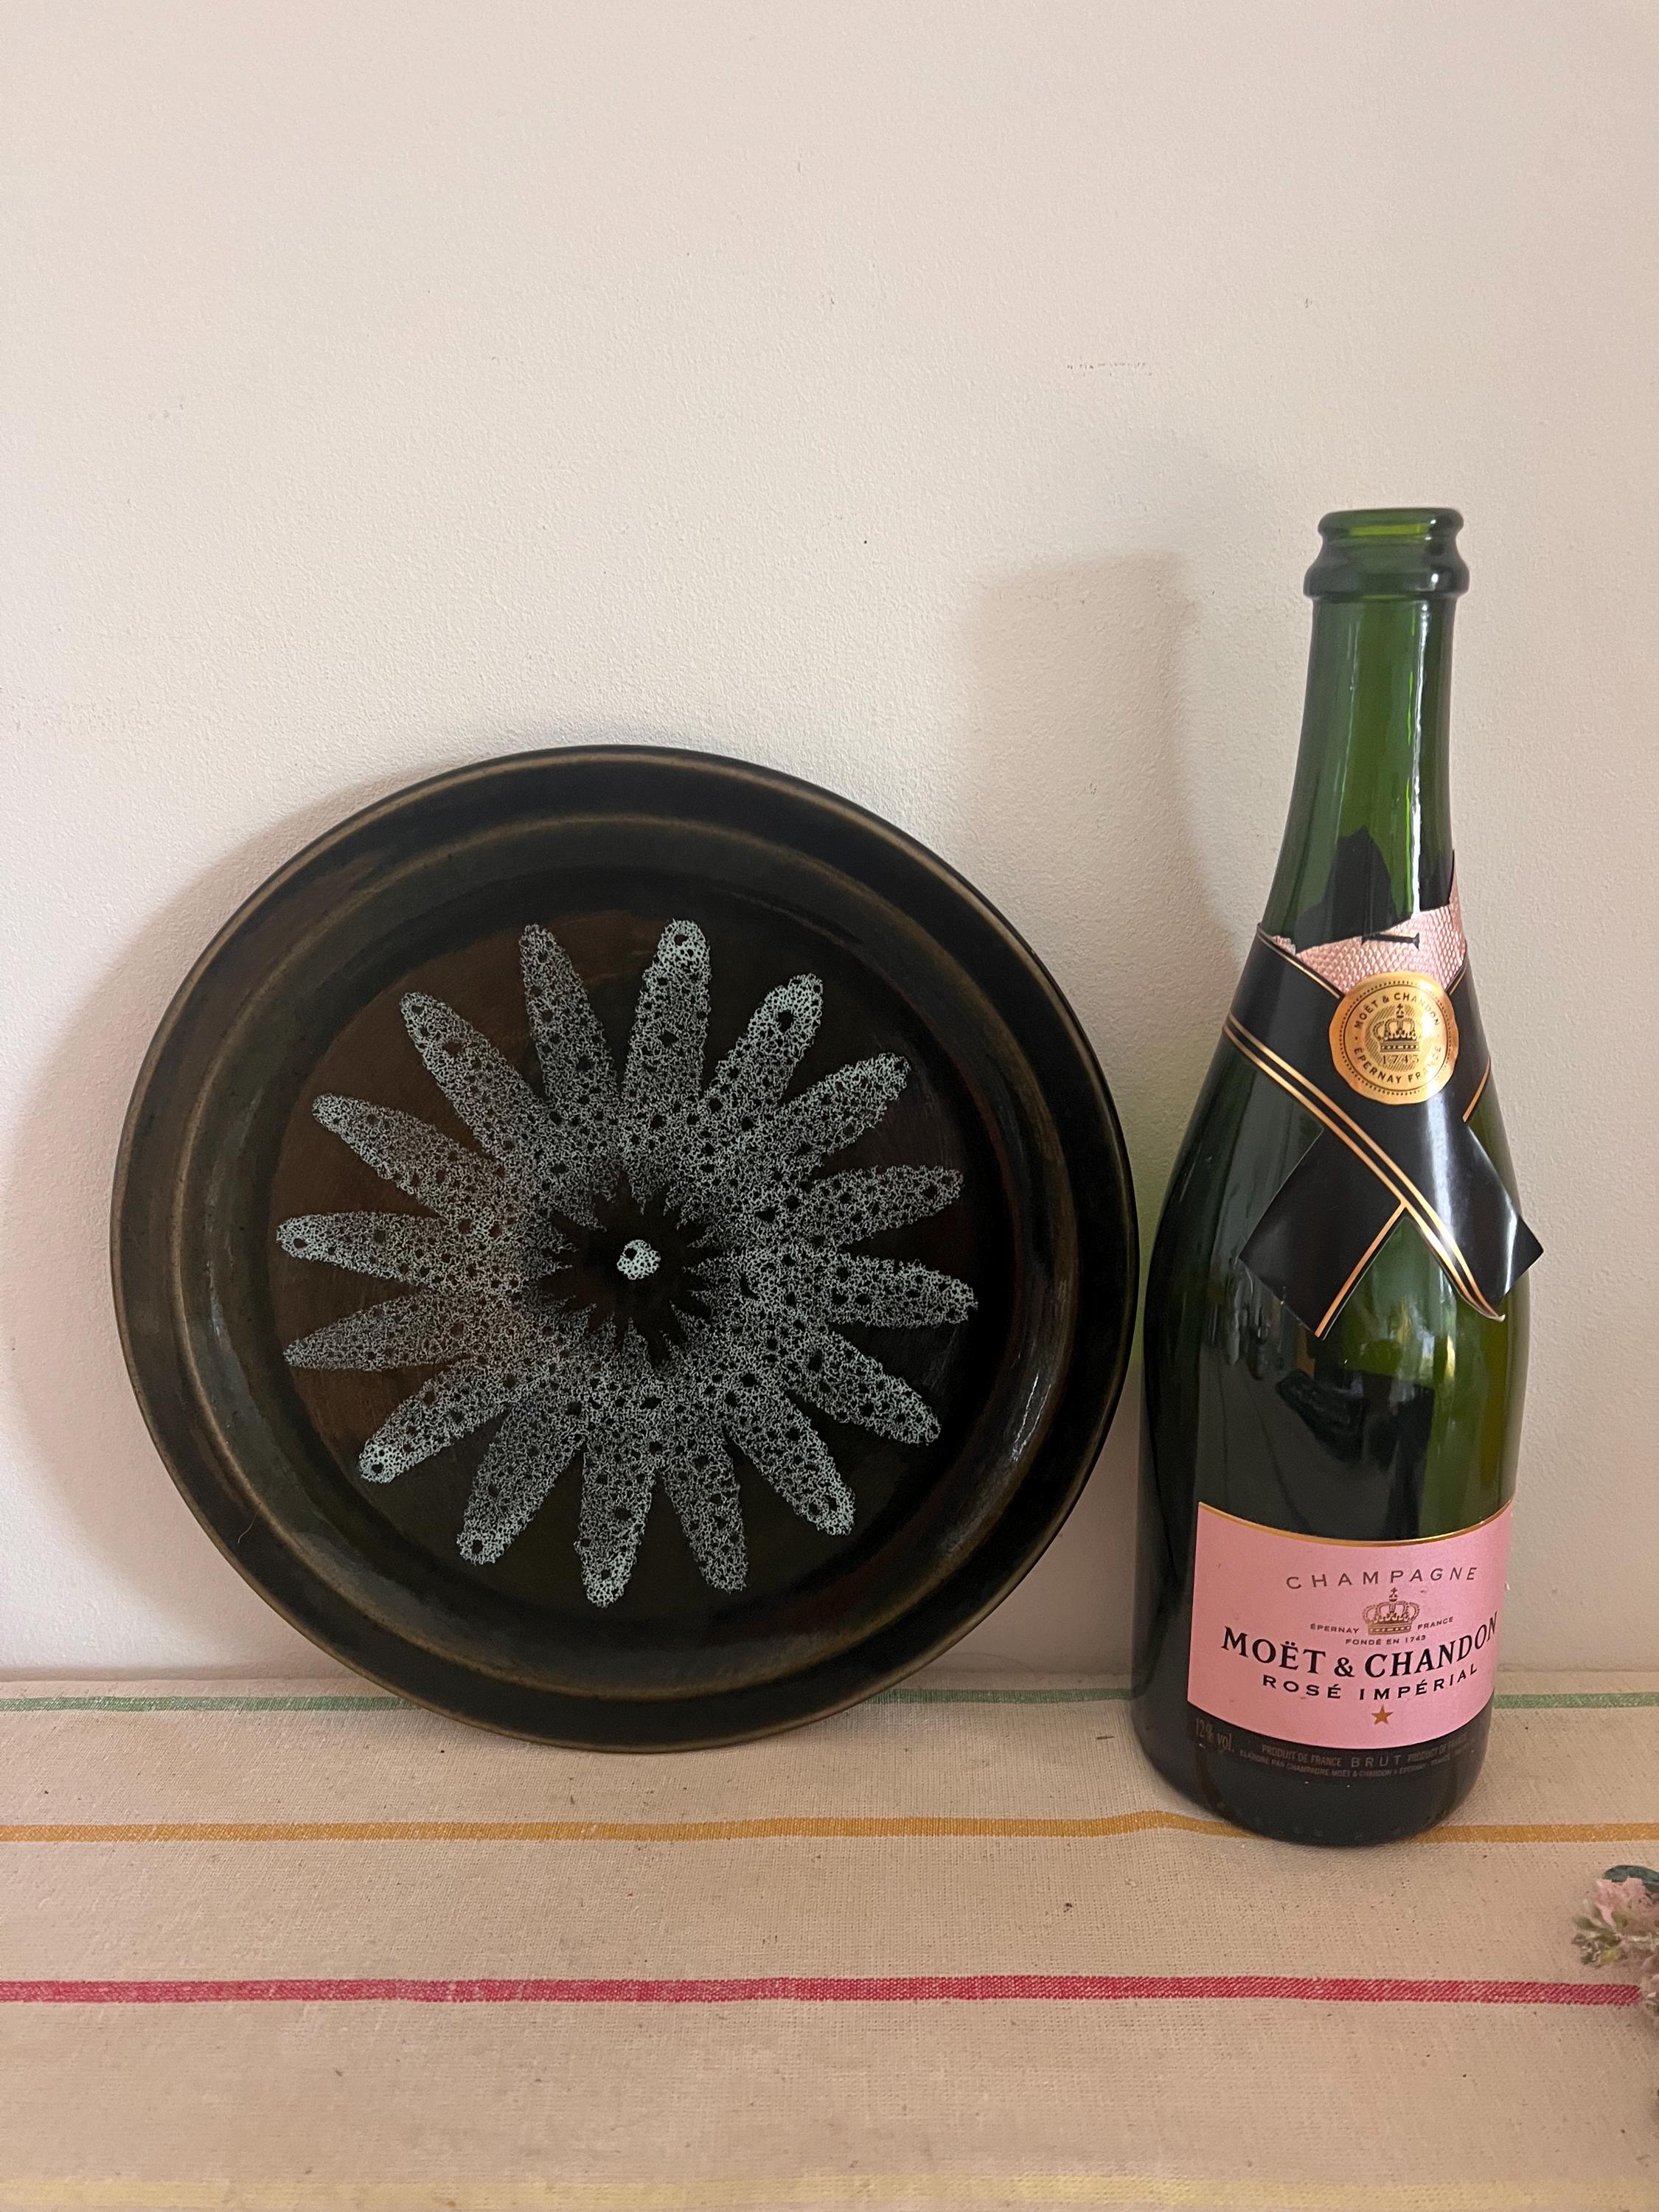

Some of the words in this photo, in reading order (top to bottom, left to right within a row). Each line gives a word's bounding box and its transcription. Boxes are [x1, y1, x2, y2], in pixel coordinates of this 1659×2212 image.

[1382, 995, 1390, 1004] &
[1286, 1566, 1478, 1590] CHAMPAGNE
[1417, 1616, 1454, 1630] FRANCE
[1221, 1627, 1326, 1674] MOËT
[1333, 1657, 1354, 1677] &
[1364, 1610, 1498, 1678] CHANDON
[1262, 1674, 1342, 1699] ROSÉ
[1359, 1663, 1478, 1701] IMPÉRIAL
[1311, 1753, 1342, 1767] FRANCE
[1351, 1755, 1402, 1768] BRUT
